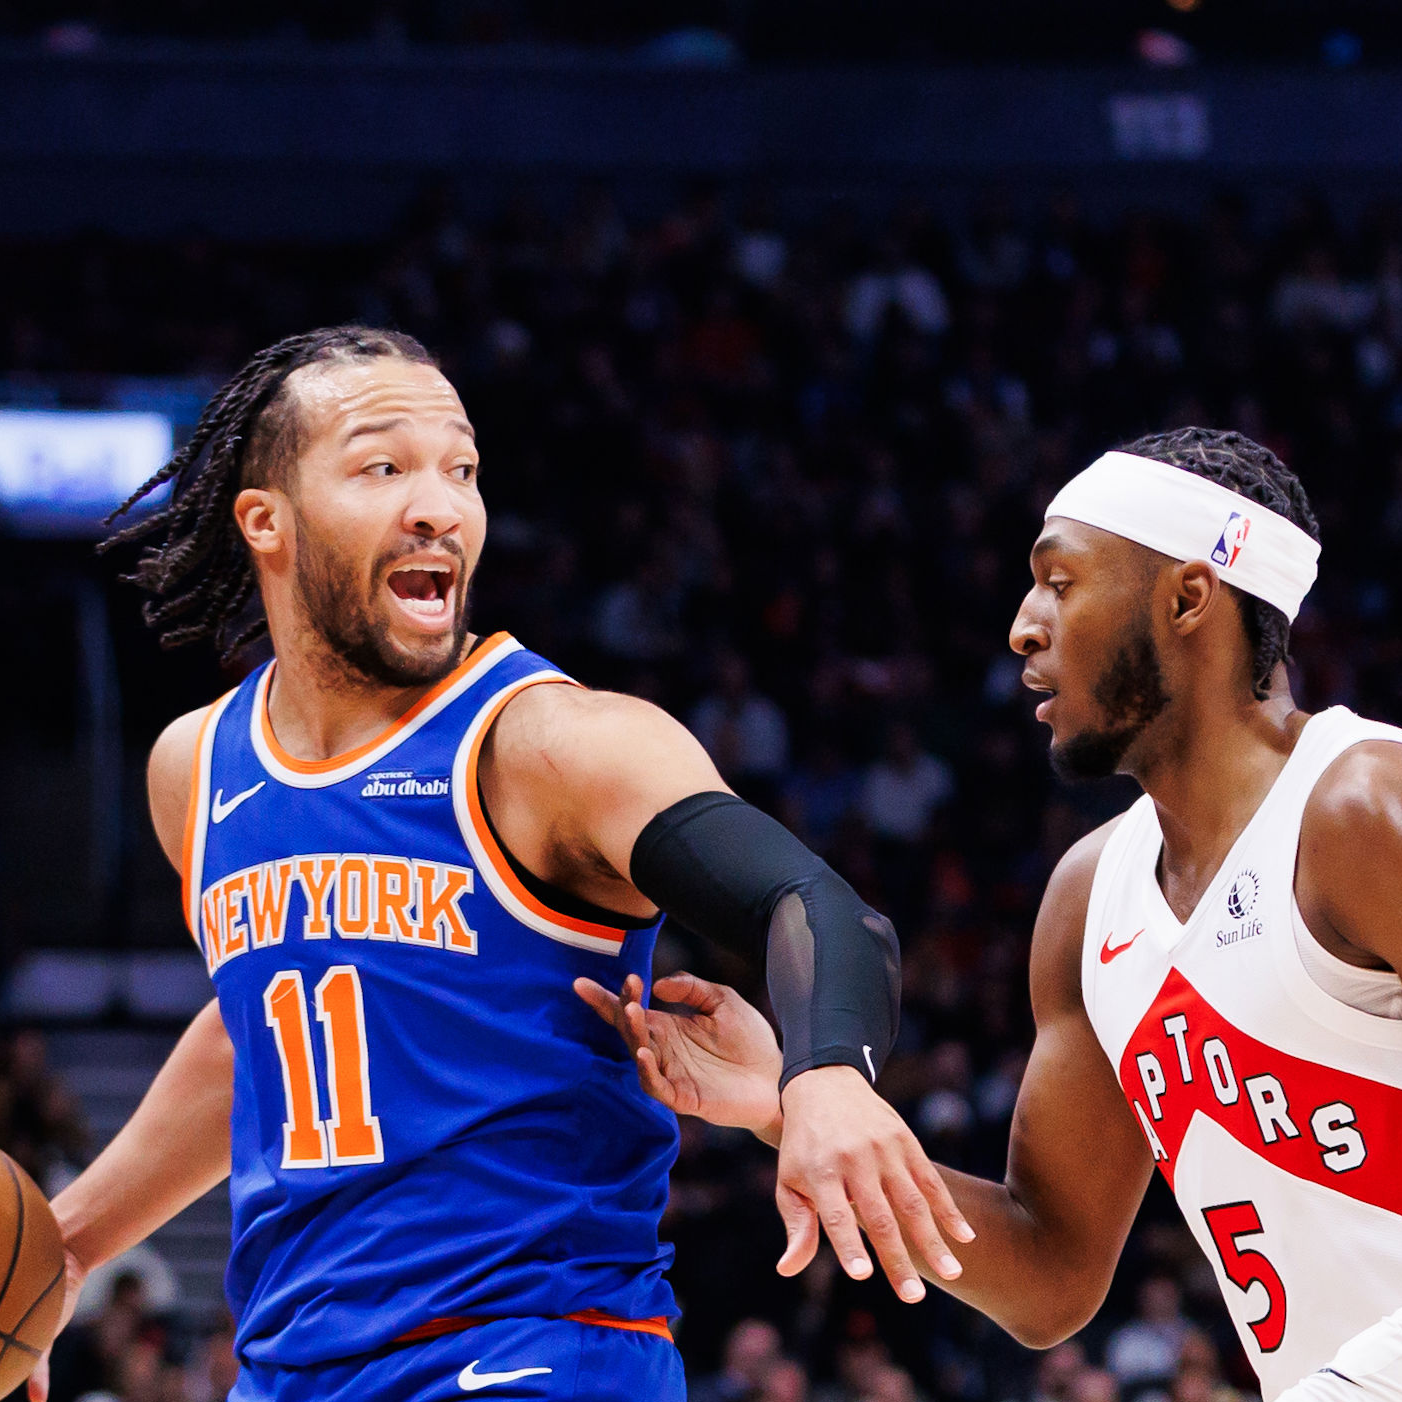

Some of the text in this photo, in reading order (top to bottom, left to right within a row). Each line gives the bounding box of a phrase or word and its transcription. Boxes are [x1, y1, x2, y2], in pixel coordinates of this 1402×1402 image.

[361, 778, 450, 796] abu dhabi
[366, 771, 414, 780] experience
[201, 853, 478, 978] NEW YORK
[1216, 918, 1263, 948] Sun Life
[263, 965, 384, 1169] 11
[1133, 1013, 1367, 1174] APTORS
[1201, 1201, 1287, 1354] 5
